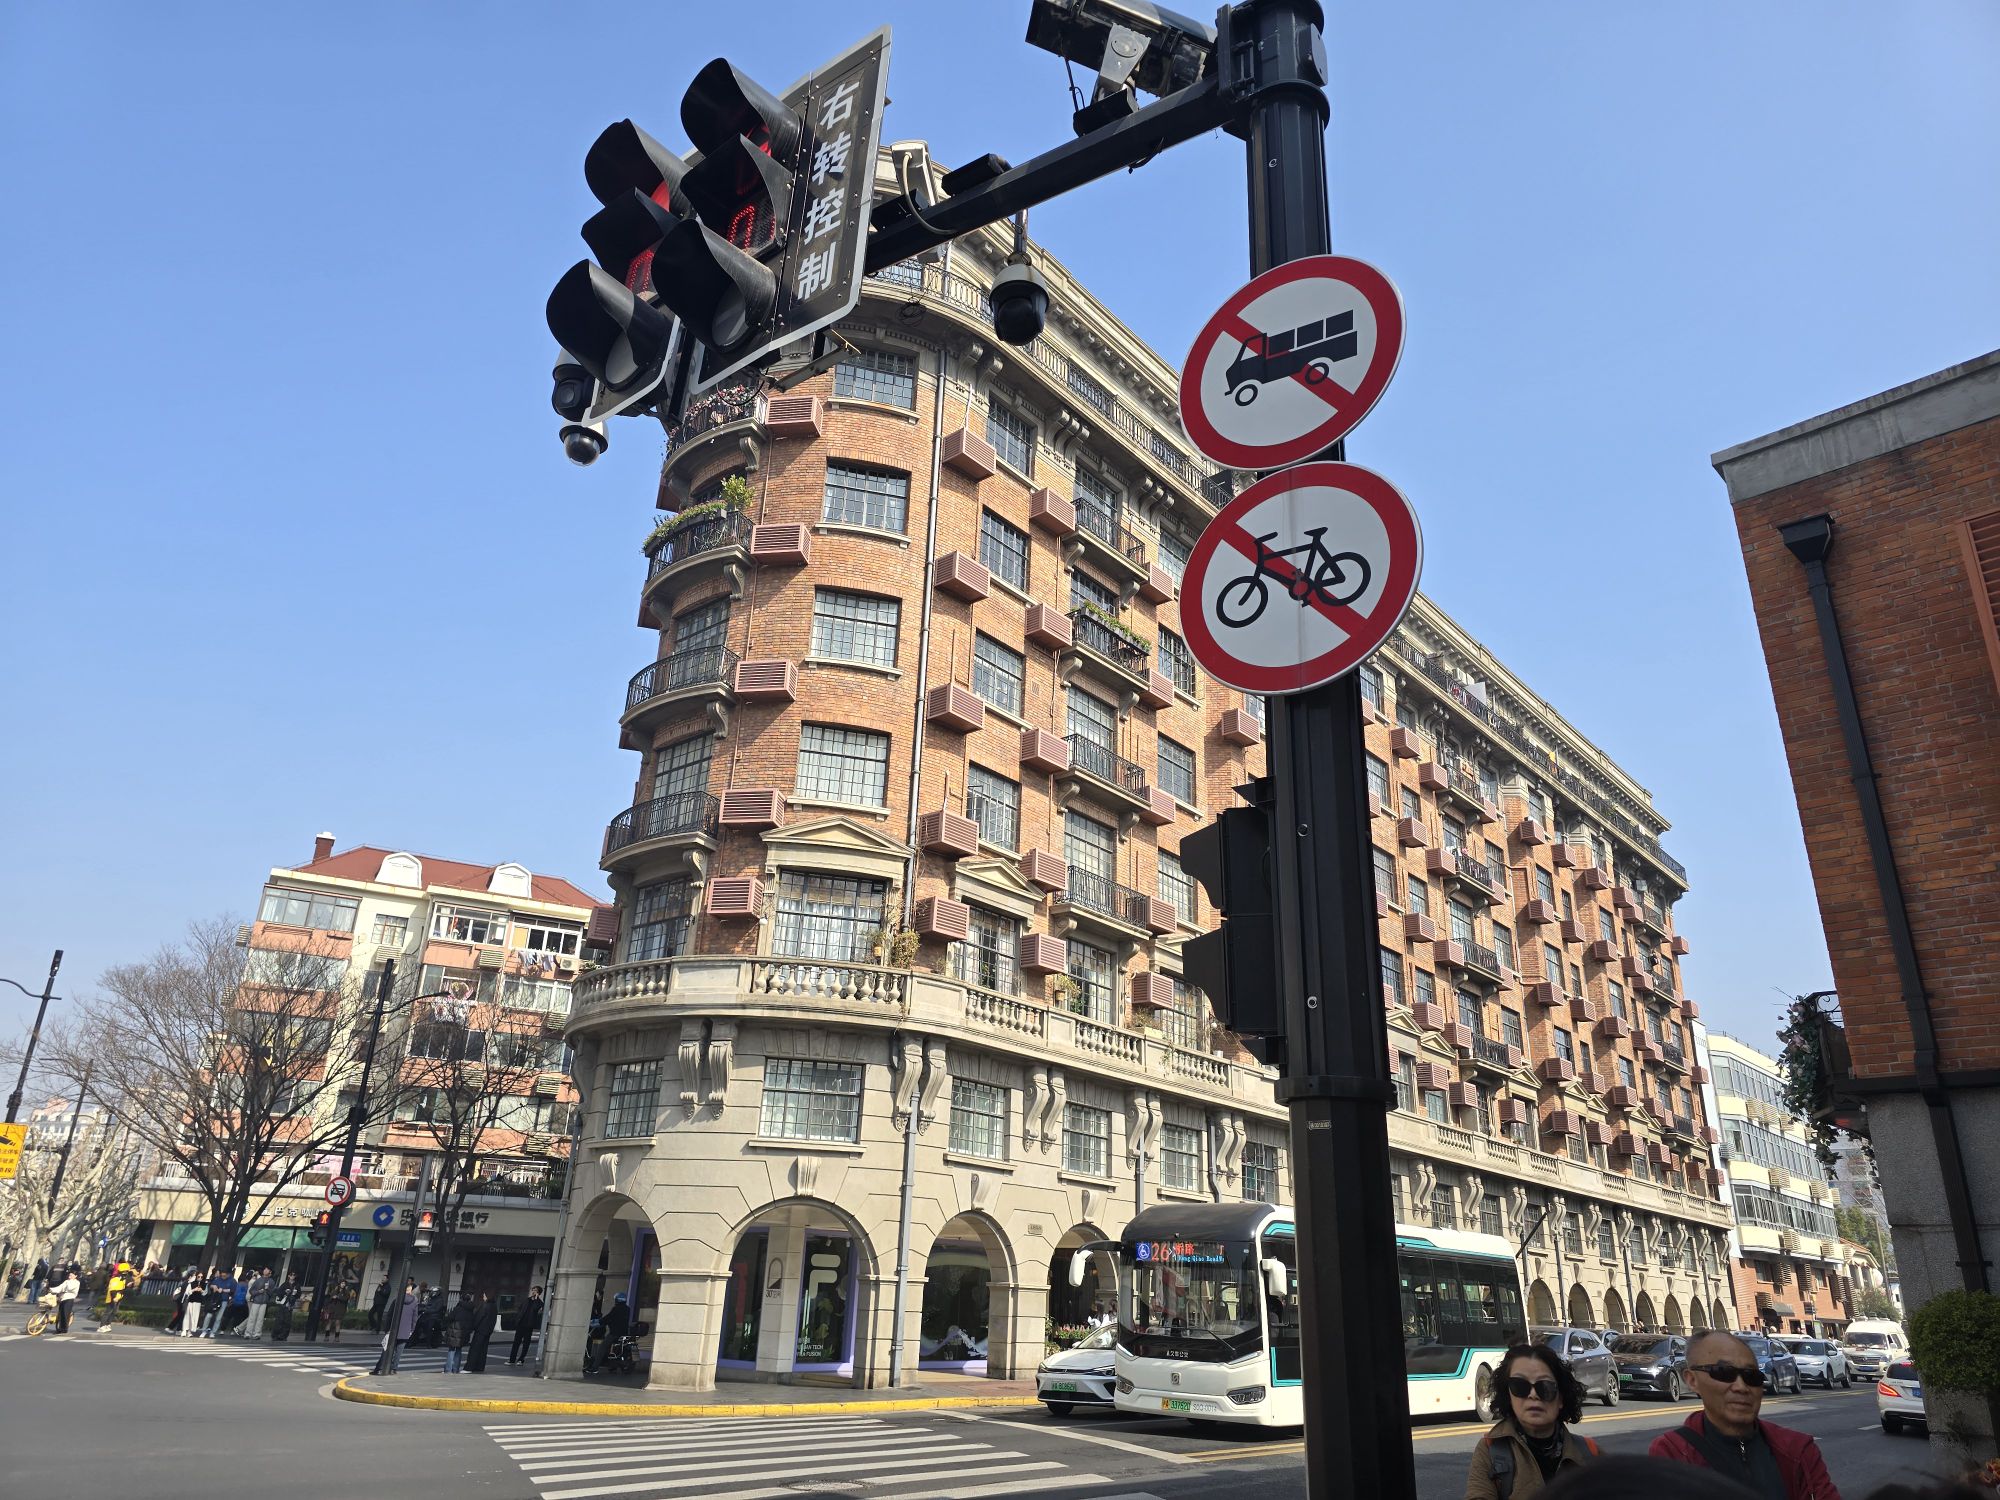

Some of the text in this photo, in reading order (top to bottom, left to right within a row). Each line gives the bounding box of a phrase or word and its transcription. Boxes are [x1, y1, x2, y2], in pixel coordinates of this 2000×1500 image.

[797, 80, 860, 302] 右转控制
[1151, 1242, 1170, 1262] 26
